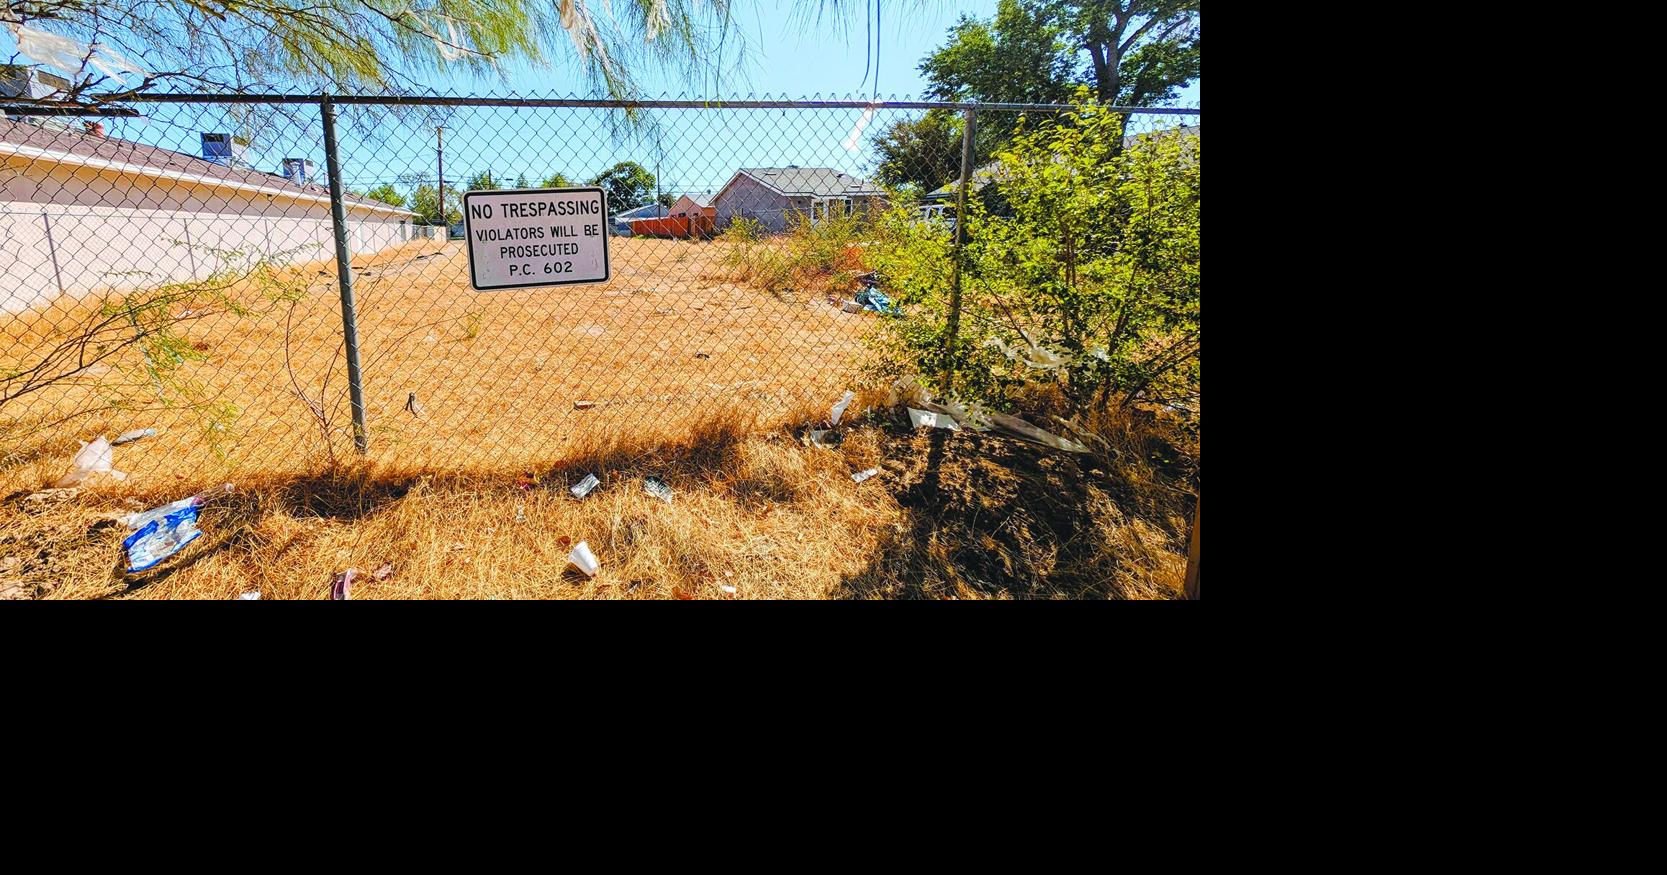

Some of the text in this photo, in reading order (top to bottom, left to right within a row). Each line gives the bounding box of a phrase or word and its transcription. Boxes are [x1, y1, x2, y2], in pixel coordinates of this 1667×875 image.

[471, 200, 600, 219] NO TRESPASSING
[476, 224, 599, 242] VIOLATORS WILL BE
[500, 243, 579, 259] PROSECUTED
[509, 261, 573, 276] P.C. 602
